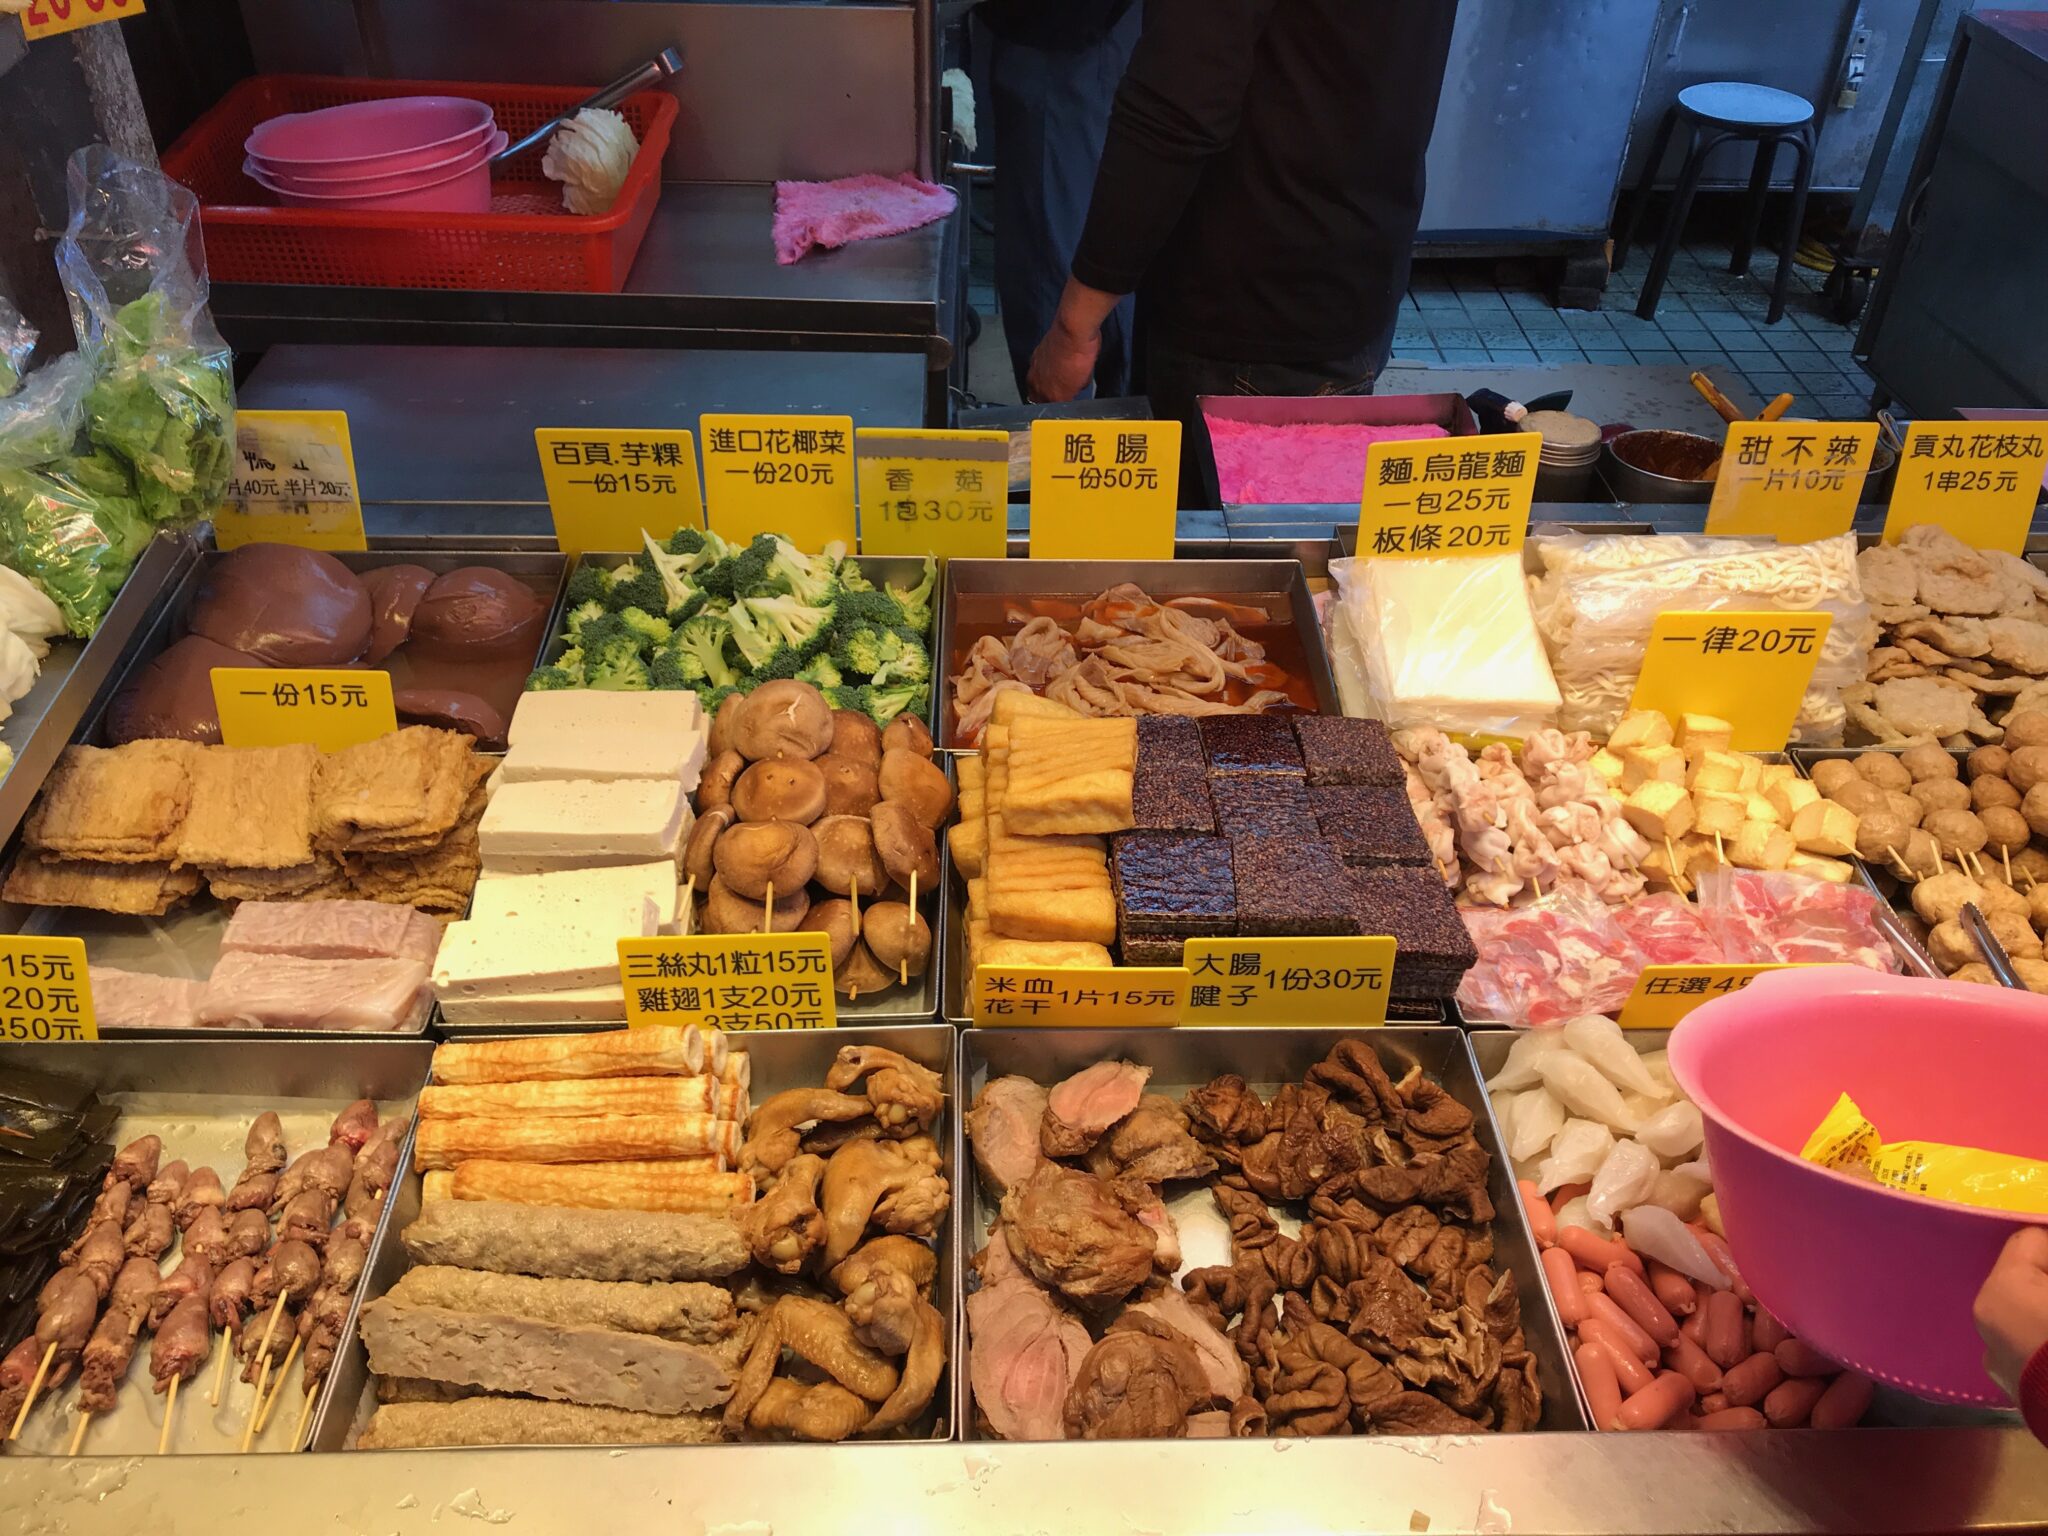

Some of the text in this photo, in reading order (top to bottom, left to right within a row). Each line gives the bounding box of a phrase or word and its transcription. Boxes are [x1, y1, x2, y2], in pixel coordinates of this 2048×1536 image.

[549, 441, 683, 467] 百頁.芋粿
[709, 428, 846, 455] 進口花椰菜
[1063, 434, 1149, 464] 脆腸
[1738, 435, 1861, 466] 甜不辣
[1909, 433, 2043, 459] 貢丸花枝丸
[567, 473, 677, 494] 一份15元
[725, 461, 834, 485] 一份20元
[1051, 467, 1158, 490] 一份50元
[1738, 469, 1846, 491] 一片10元
[1923, 471, 2018, 493] 1串25元
[1383, 488, 1511, 515] 一包25元
[1372, 523, 1511, 554] 板條20元
[1662, 626, 1817, 655] 一律20元
[240, 683, 368, 708] 一份15元
[1, 953, 75, 981] 15元
[626, 949, 827, 979] 三絲丸1粒15元
[1193, 952, 1262, 977] 大腸
[984, 976, 1054, 994] 米血
[1263, 967, 1383, 991] 1份30元
[3, 986, 80, 1013] 20元
[637, 982, 822, 1013] 雞翅1支20元
[983, 998, 1051, 1015] 花干
[1056, 989, 1176, 1006] 1片15元
[1190, 985, 1258, 1008] 腱子
[703, 1011, 825, 1031] 3支50元
